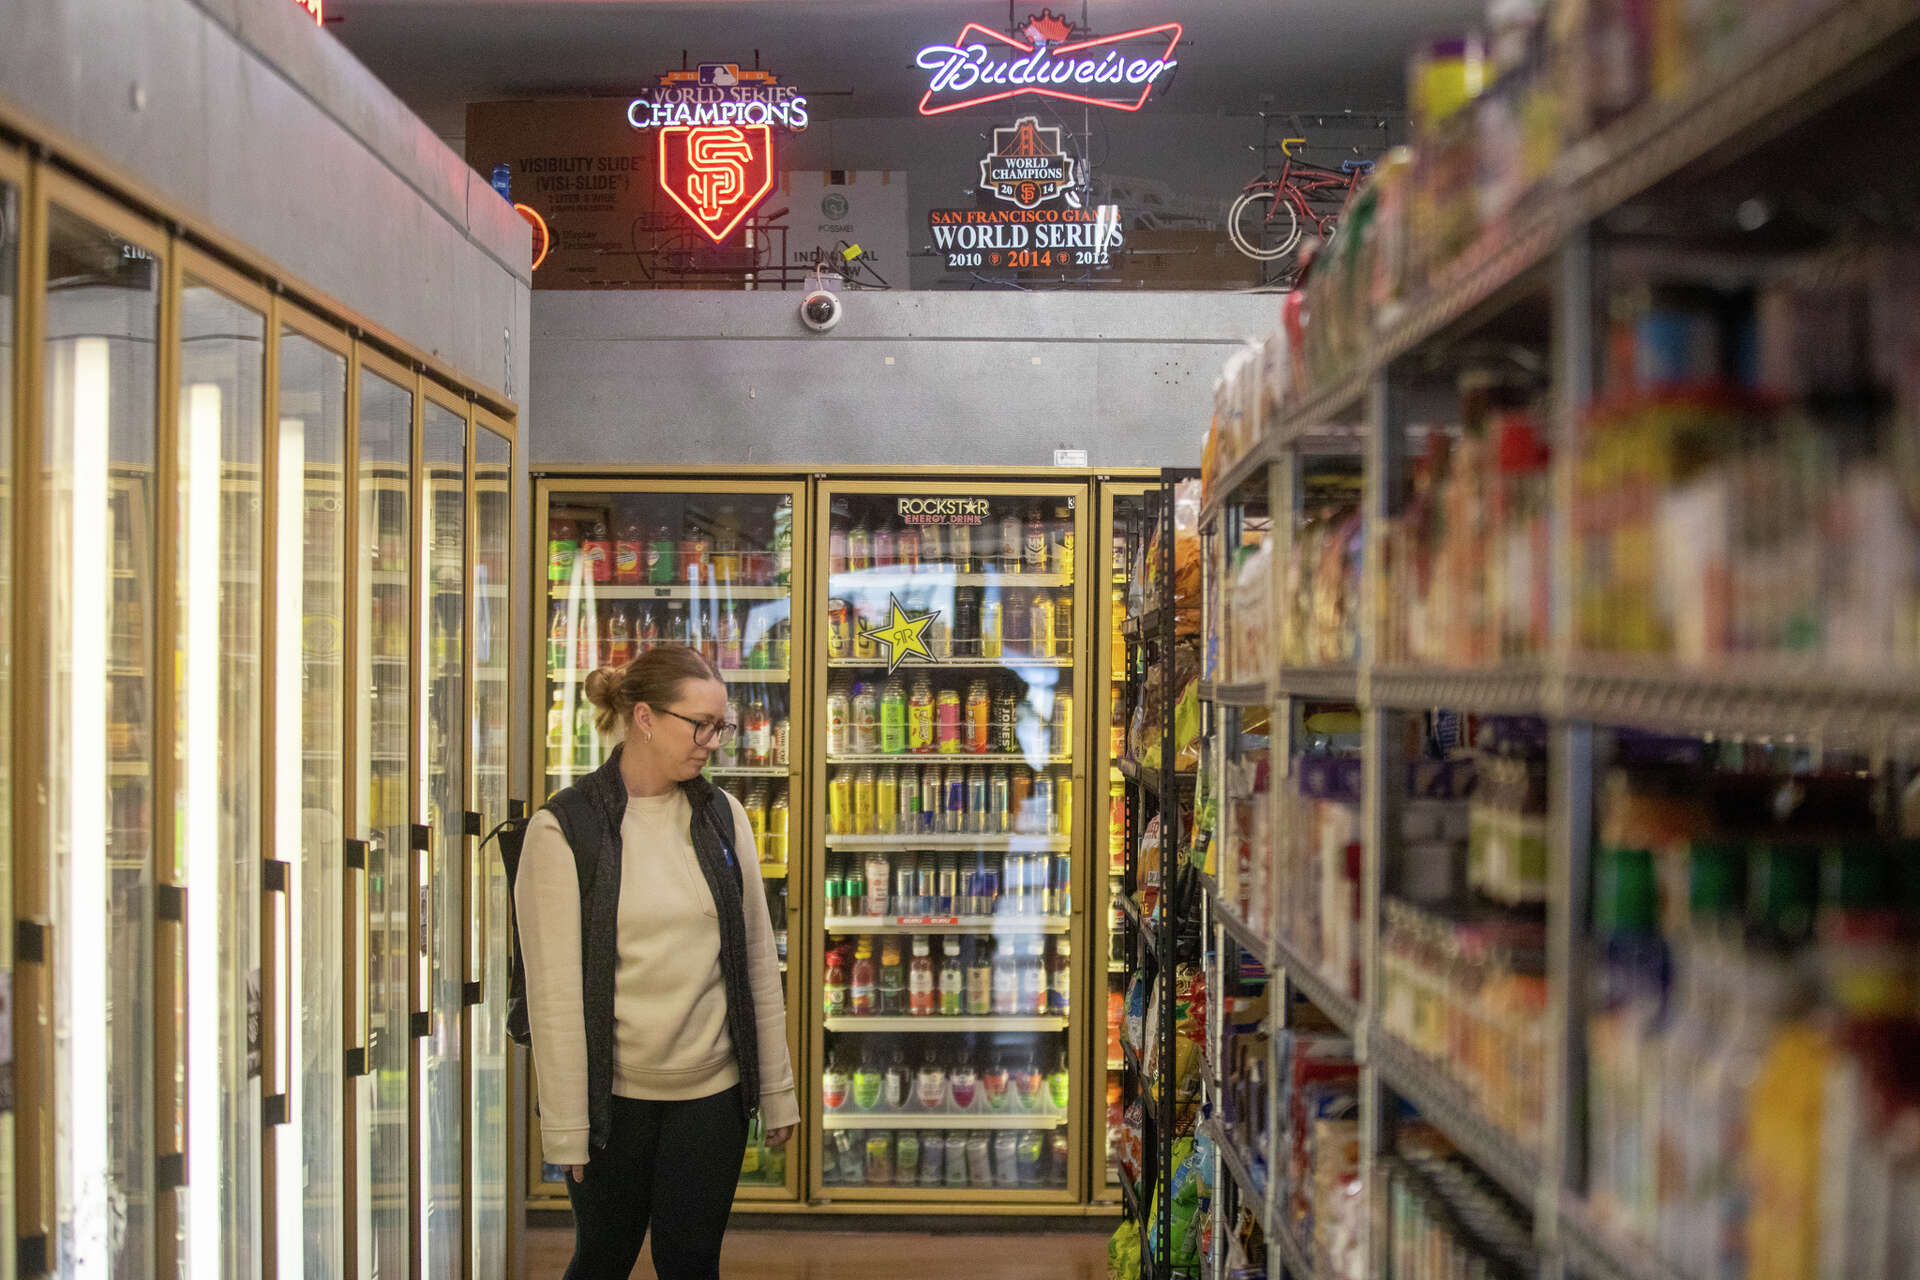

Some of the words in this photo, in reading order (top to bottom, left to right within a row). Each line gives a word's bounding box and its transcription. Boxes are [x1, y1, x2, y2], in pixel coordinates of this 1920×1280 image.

[916, 44, 1178, 91] Budweiser
[627, 98, 809, 129] CHAMPIONS
[520, 157, 593, 173] VISIBILITY
[597, 156, 641, 172] SLIDE
[1005, 157, 1049, 169] WORLD
[992, 168, 1062, 180] CHAMPIONS
[1001, 184, 1013, 195] 20
[1042, 183, 1054, 194] 14
[932, 211, 963, 224] SAN
[967, 209, 1058, 224] FRANCISCO
[932, 224, 1029, 249] WORLD
[949, 253, 982, 267] 2010
[1007, 250, 1051, 267] 2014
[1076, 251, 1109, 265] 2012
[905, 514, 946, 524] ENERGY
[950, 514, 980, 524] DRINK
[1002, 708, 1010, 747] JONES
